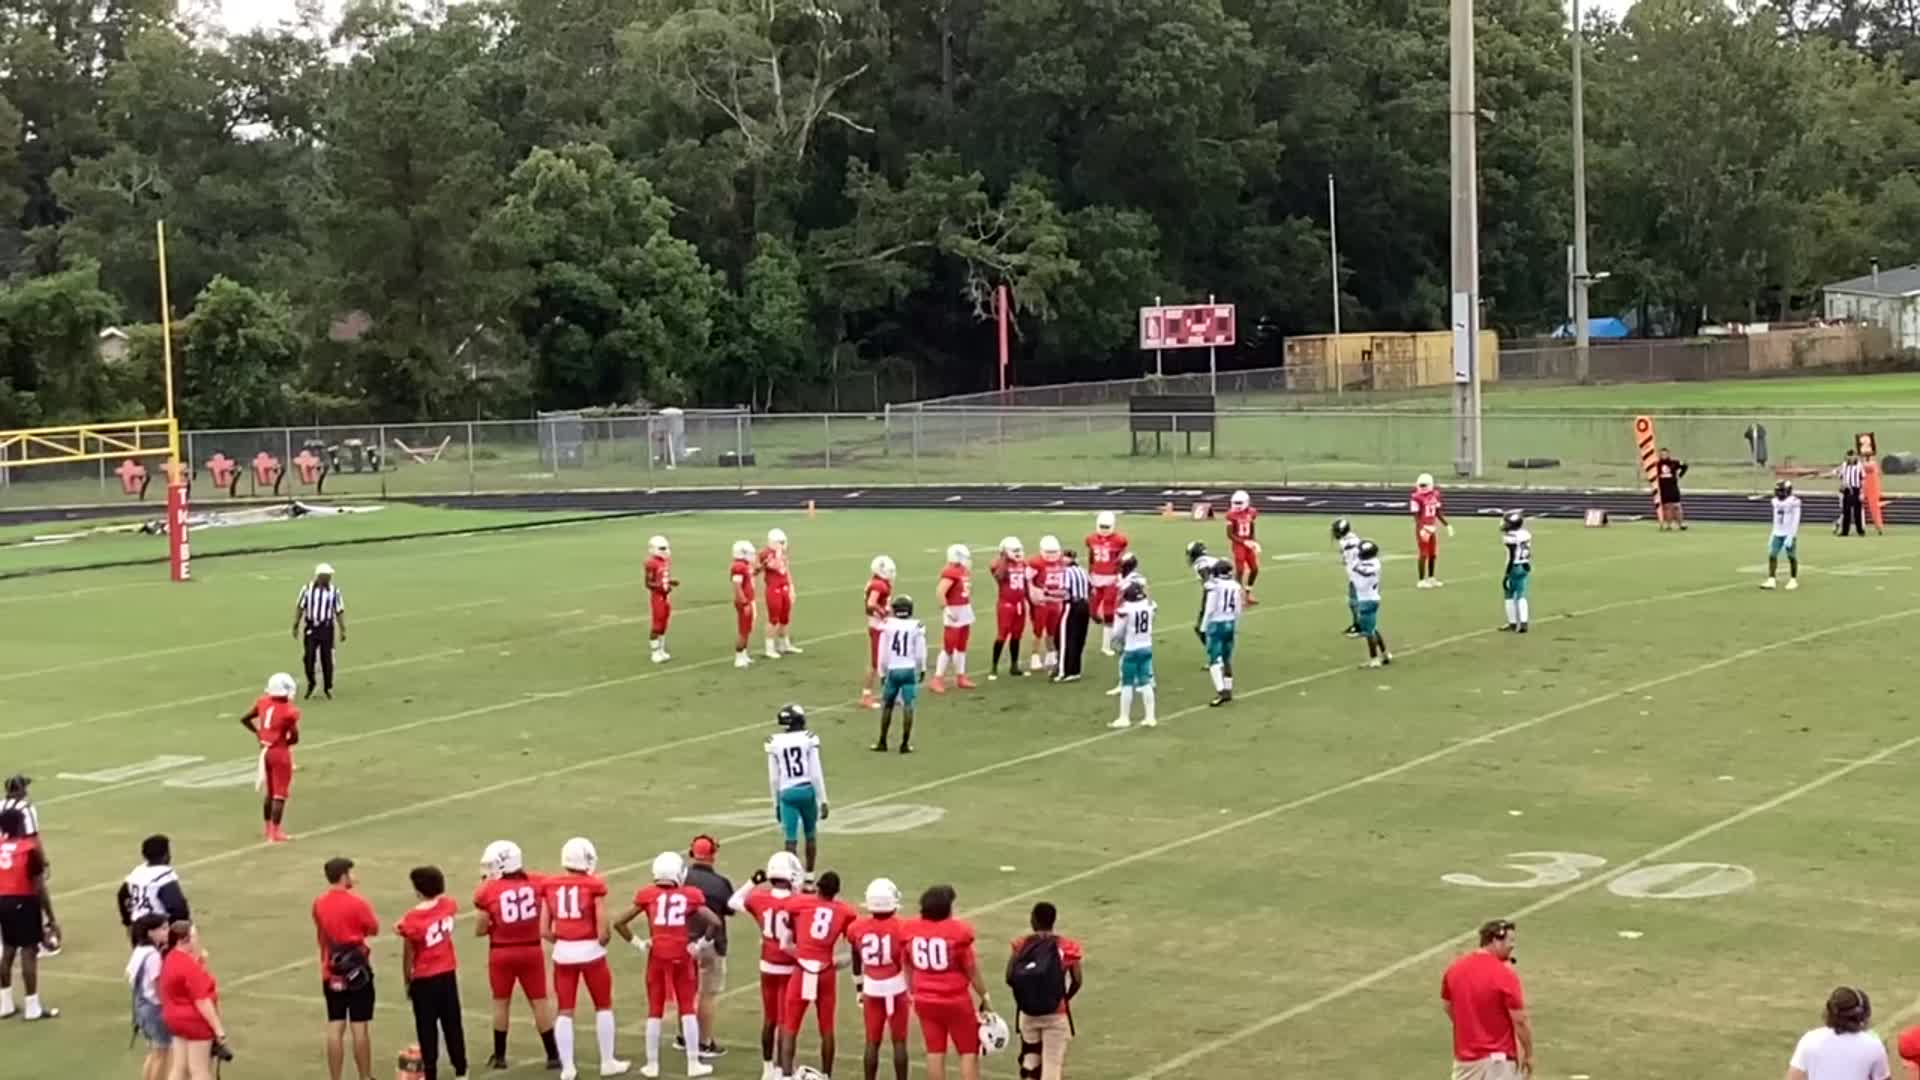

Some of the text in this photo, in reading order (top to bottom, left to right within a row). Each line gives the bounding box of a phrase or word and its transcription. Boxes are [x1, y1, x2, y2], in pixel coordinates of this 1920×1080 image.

[1223, 588, 1236, 613] 14
[1134, 611, 1149, 633] 18
[891, 630, 909, 656] 41
[264, 706, 275, 729] 1
[783, 746, 804, 778] 13
[1441, 850, 1756, 899] 30
[500, 886, 537, 924] 62
[556, 885, 582, 919] 11
[653, 893, 688, 926] 12
[810, 906, 833, 940] 8
[861, 934, 892, 965] 21
[912, 937, 948, 971] 60
